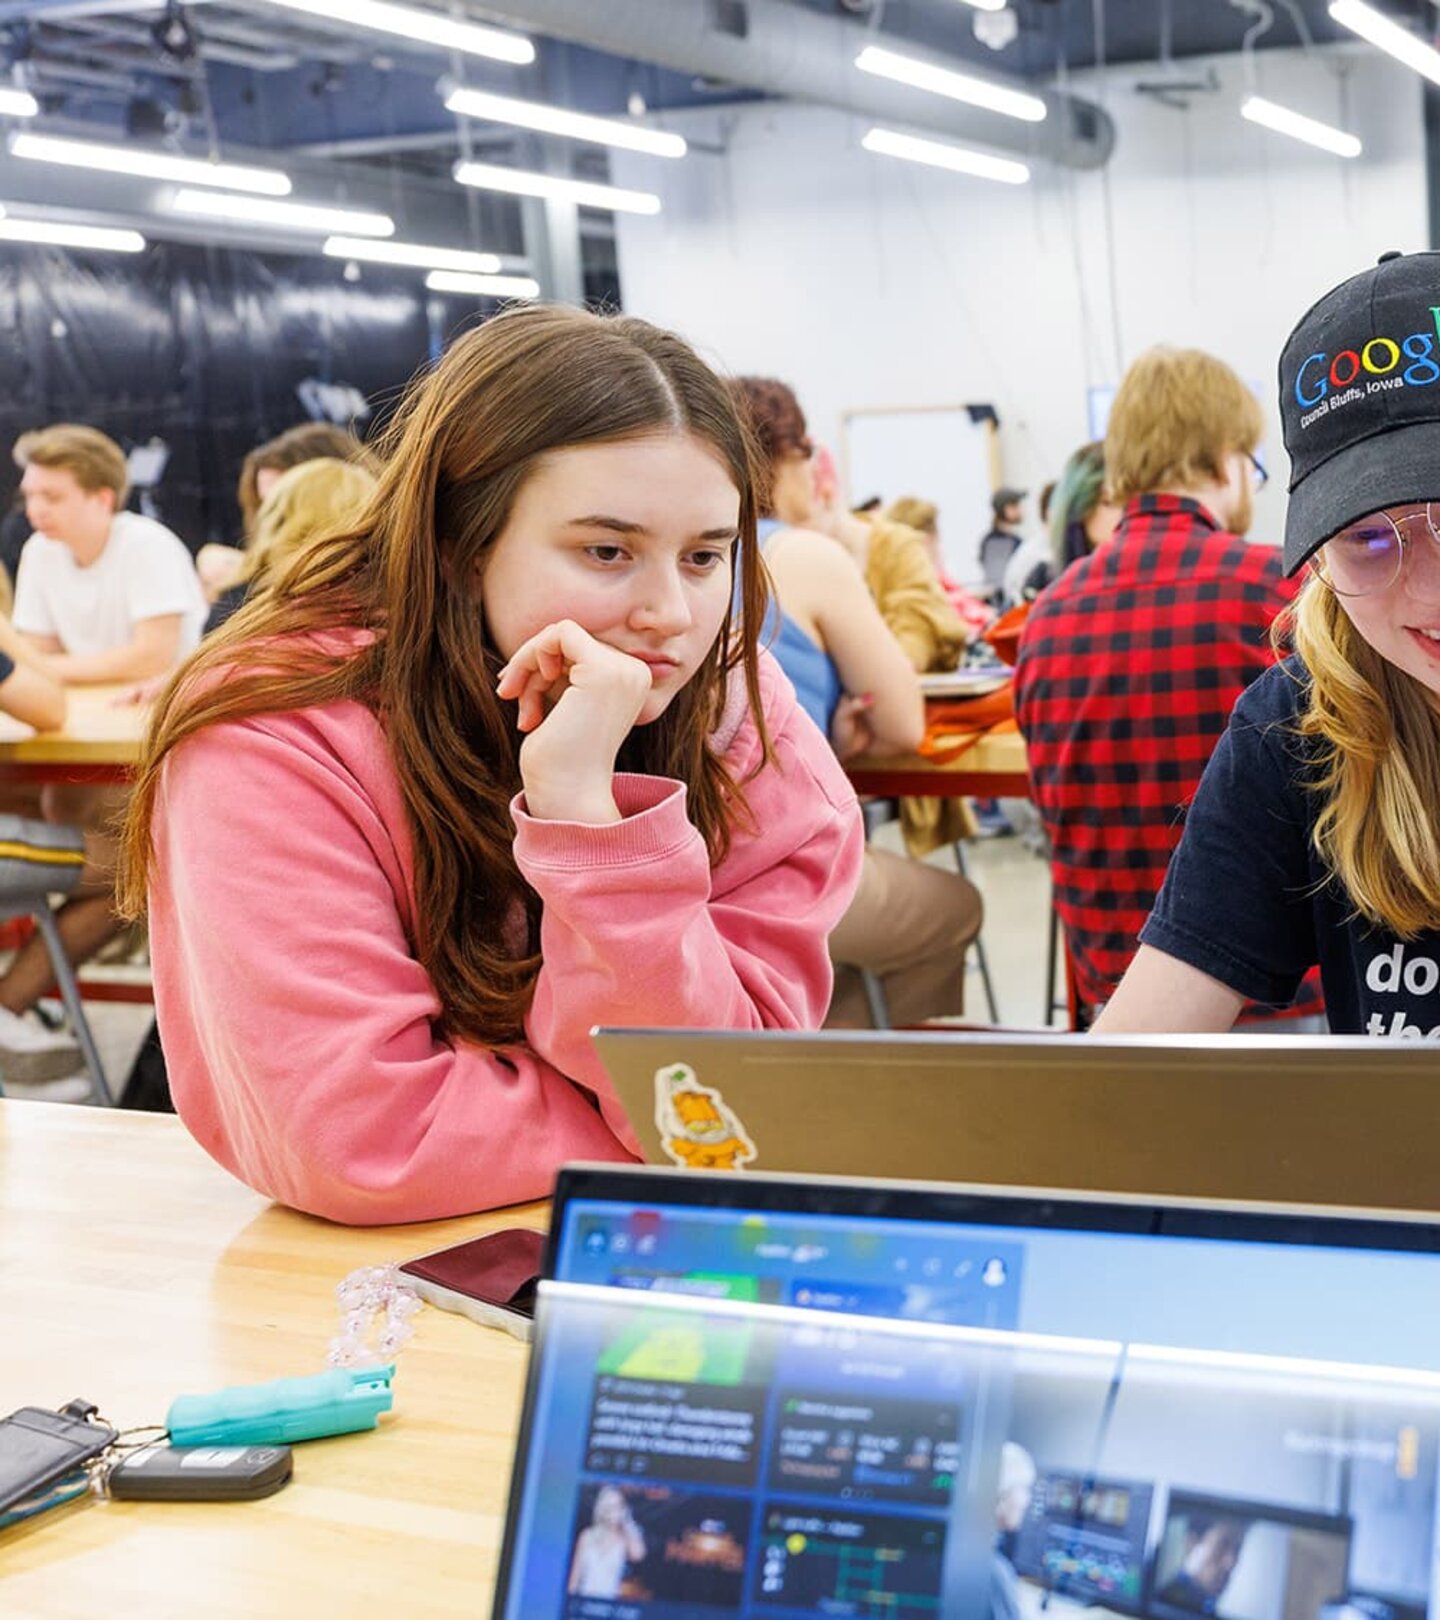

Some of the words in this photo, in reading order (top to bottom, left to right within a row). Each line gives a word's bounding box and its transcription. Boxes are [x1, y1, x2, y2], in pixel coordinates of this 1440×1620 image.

[1301, 401, 1329, 429] Council
[1329, 387, 1366, 411] Bluffs,
[1365, 376, 1404, 394] Iowa
